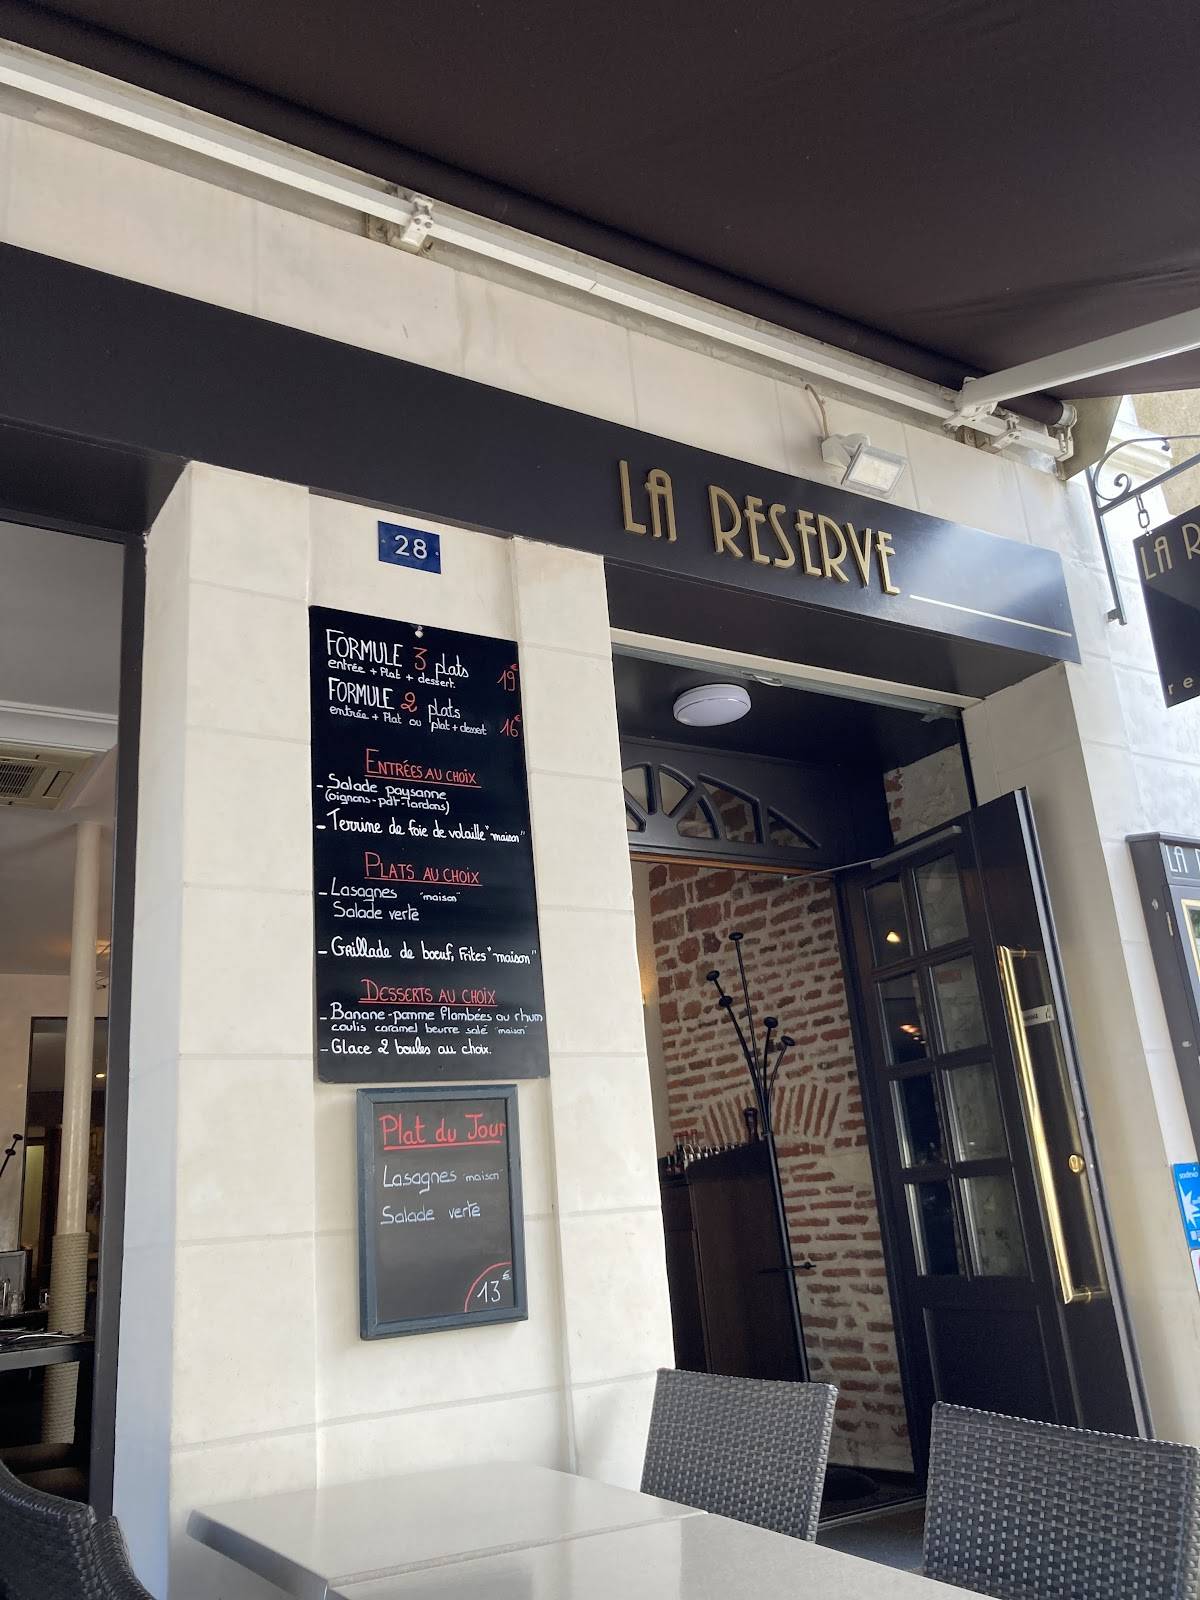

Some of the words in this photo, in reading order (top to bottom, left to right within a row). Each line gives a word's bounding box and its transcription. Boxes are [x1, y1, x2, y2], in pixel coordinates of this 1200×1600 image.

[618, 459, 677, 543] LA
[708, 484, 900, 595] RESERVE
[394, 534, 428, 559] 28
[1140, 534, 1173, 580] LA
[326, 629, 403, 667] FORMULE
[413, 647, 428, 670] 3
[435, 653, 469, 678] plats
[328, 659, 365, 674] entrée
[380, 667, 401, 679] Plat
[328, 677, 395, 710] FORMULE
[400, 692, 418, 712] 2
[428, 698, 461, 723] plats
[329, 705, 369, 720] entrée
[383, 711, 402, 724] Plat
[409, 718, 422, 727] ou
[364, 748, 423, 779] ENTRÉES
[424, 769, 442, 781] AU
[446, 769, 477, 784] CHOIX
[327, 773, 378, 792] Salade
[385, 785, 447, 800] paysanne
[326, 808, 383, 834] Terrine
[389, 816, 405, 836] de
[408, 819, 429, 837] foie
[433, 819, 447, 838] de
[448, 823, 486, 841] volaille
[364, 852, 415, 880] PLATS
[423, 865, 439, 882] AU
[443, 867, 480, 884] CHOIX
[1165, 845, 1188, 873] LA
[331, 877, 398, 902] Lasagnes
[333, 901, 383, 920] Salade
[389, 904, 420, 921] verte
[331, 936, 392, 959] Grillade
[400, 941, 415, 960] de
[459, 946, 487, 962] Frites
[360, 978, 433, 1003] DESSERTS
[439, 991, 456, 1004] AU
[462, 987, 497, 1004] CHOIX
[440, 1006, 492, 1022] flambées
[496, 1012, 511, 1022] au
[515, 1008, 543, 1022] rhum
[331, 1021, 367, 1032] coulis
[375, 1022, 418, 1034] caramel
[425, 1023, 460, 1034] beurre
[465, 1024, 489, 1035] salé
[331, 1038, 373, 1055] Glace
[378, 1039, 390, 1055] 2
[396, 1037, 431, 1055] boules
[437, 1045, 457, 1055] au
[379, 1112, 425, 1147] Plat
[435, 1118, 457, 1143] du
[465, 1113, 506, 1139] Jour
[383, 1165, 457, 1195] Lasagnes
[380, 1205, 435, 1225] Salade
[448, 1200, 481, 1220] verte
